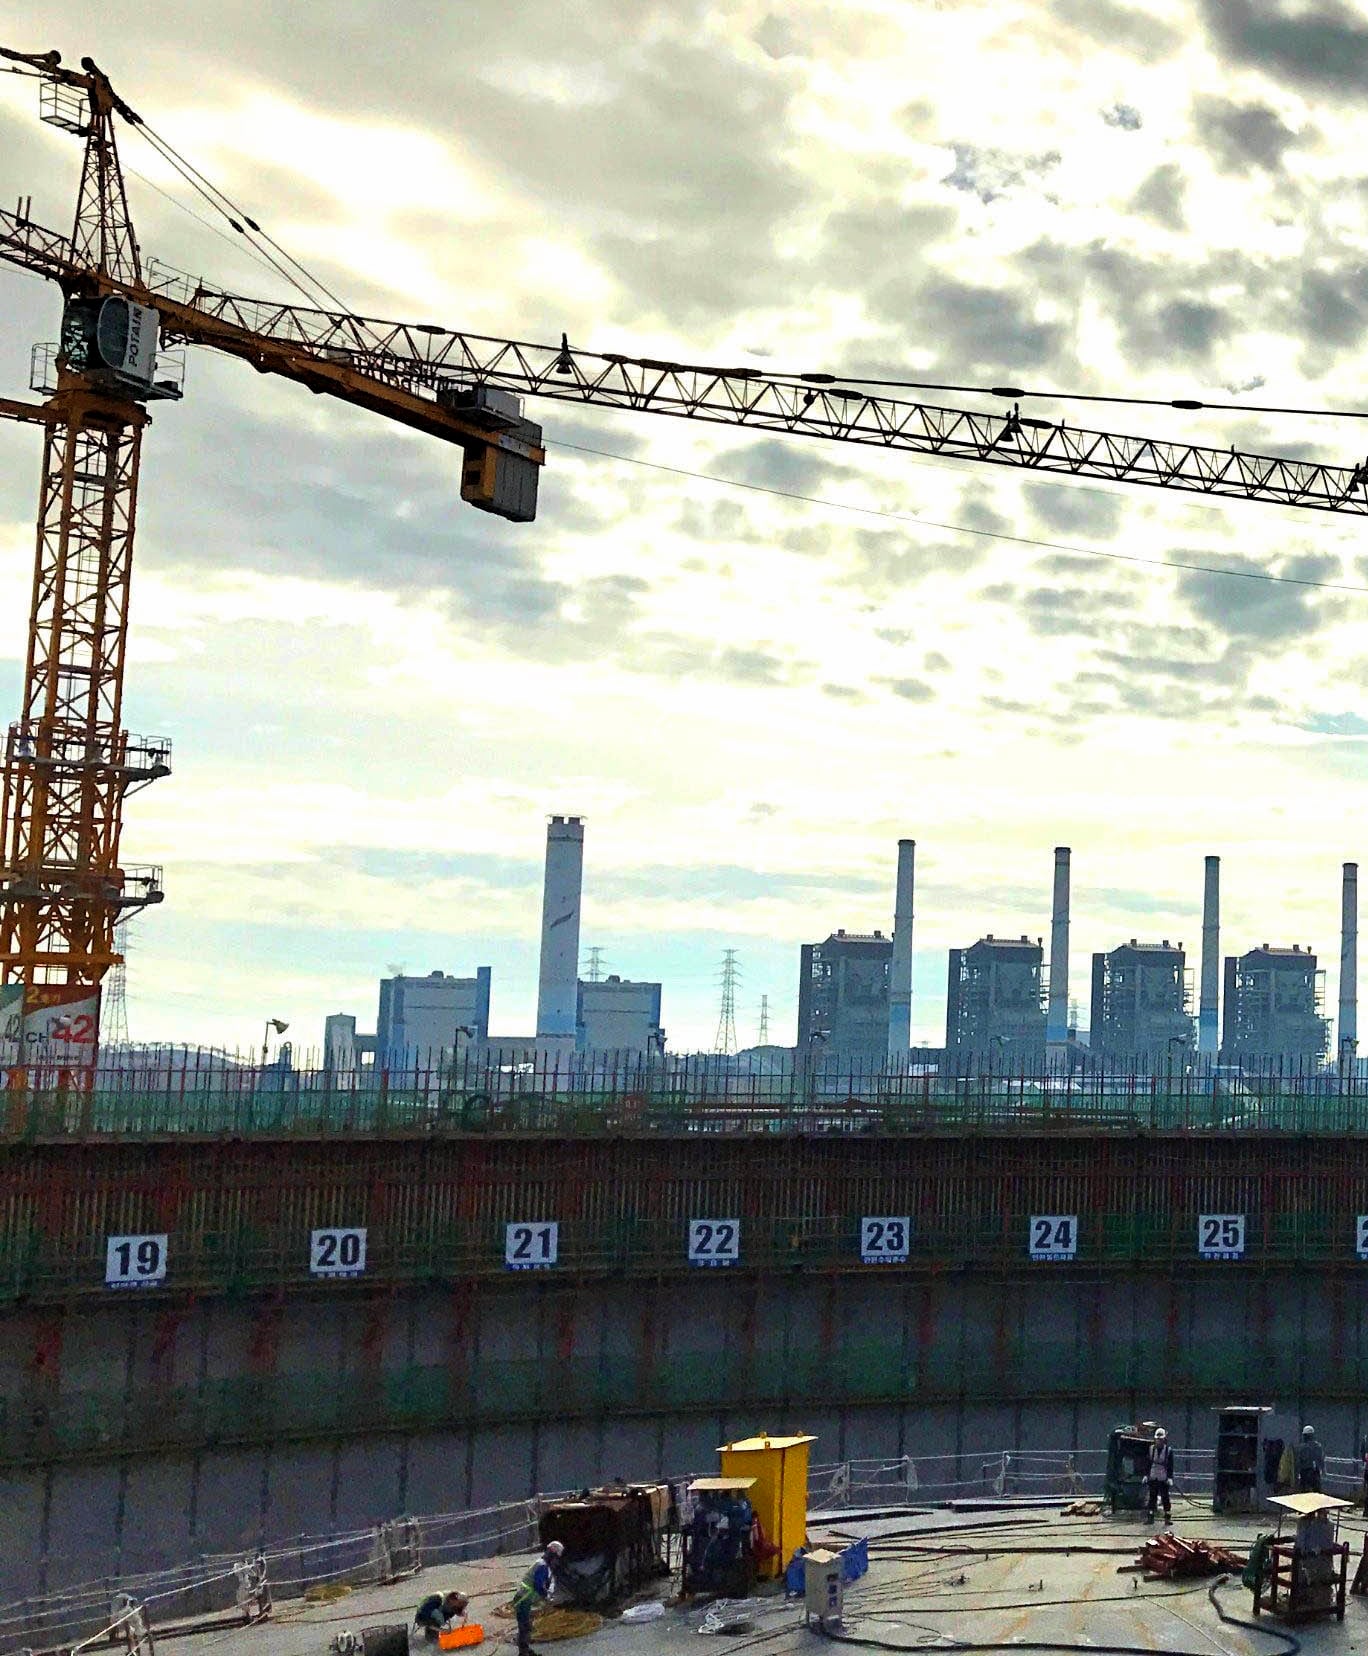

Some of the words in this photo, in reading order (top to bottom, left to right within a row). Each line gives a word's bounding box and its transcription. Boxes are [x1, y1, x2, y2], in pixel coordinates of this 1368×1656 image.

[129, 307, 143, 367] POTAIN
[512, 1227, 551, 1260] 21
[693, 1224, 734, 1255] 22
[865, 1221, 905, 1252] 23
[1034, 1219, 1073, 1250] 24
[1203, 1219, 1240, 1248] 25
[114, 1240, 160, 1277] 19
[316, 1233, 361, 1267] 20
